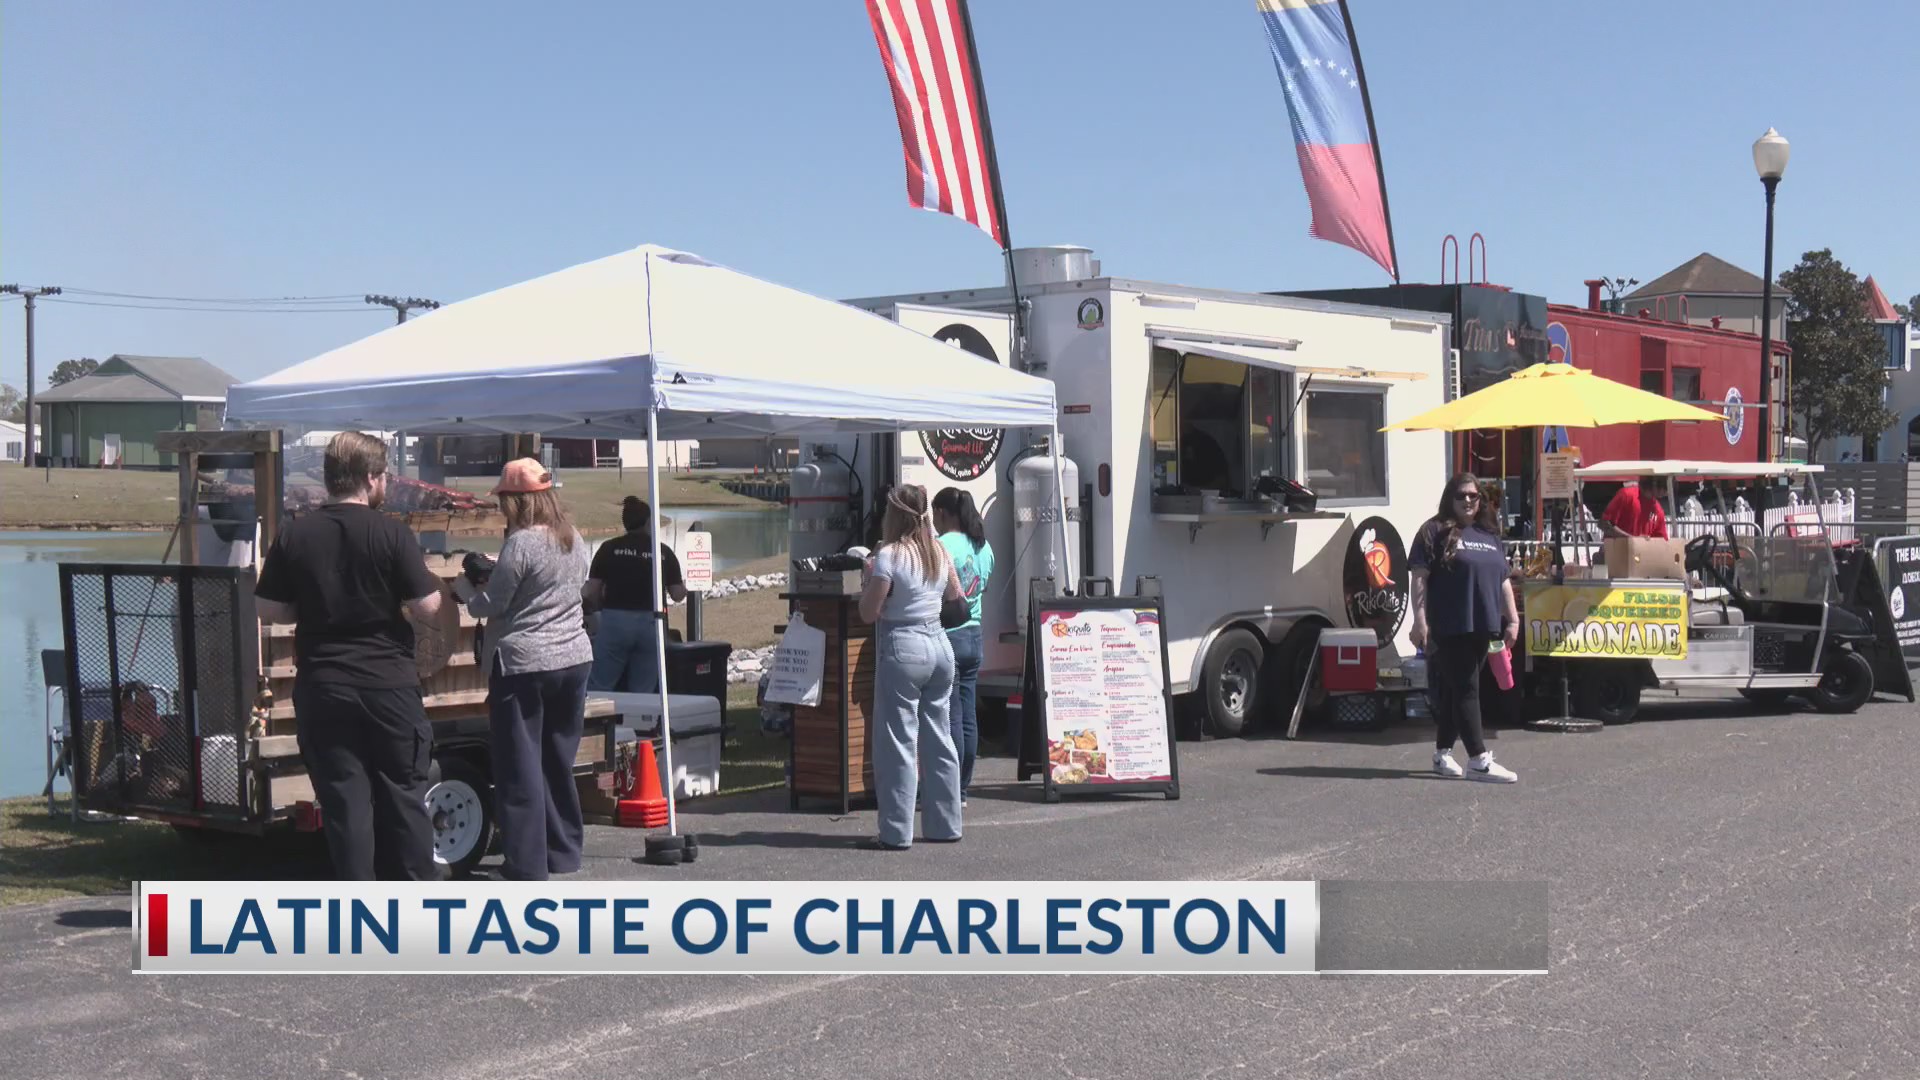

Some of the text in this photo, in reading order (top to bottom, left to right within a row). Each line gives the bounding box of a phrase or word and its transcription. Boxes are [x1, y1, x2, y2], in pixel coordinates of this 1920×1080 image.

[1895, 547, 1910, 562] THE
[1623, 591, 1681, 605] FRESH
[1587, 605, 1682, 620] SQUEEZED
[1531, 619, 1682, 656] LEMONADE
